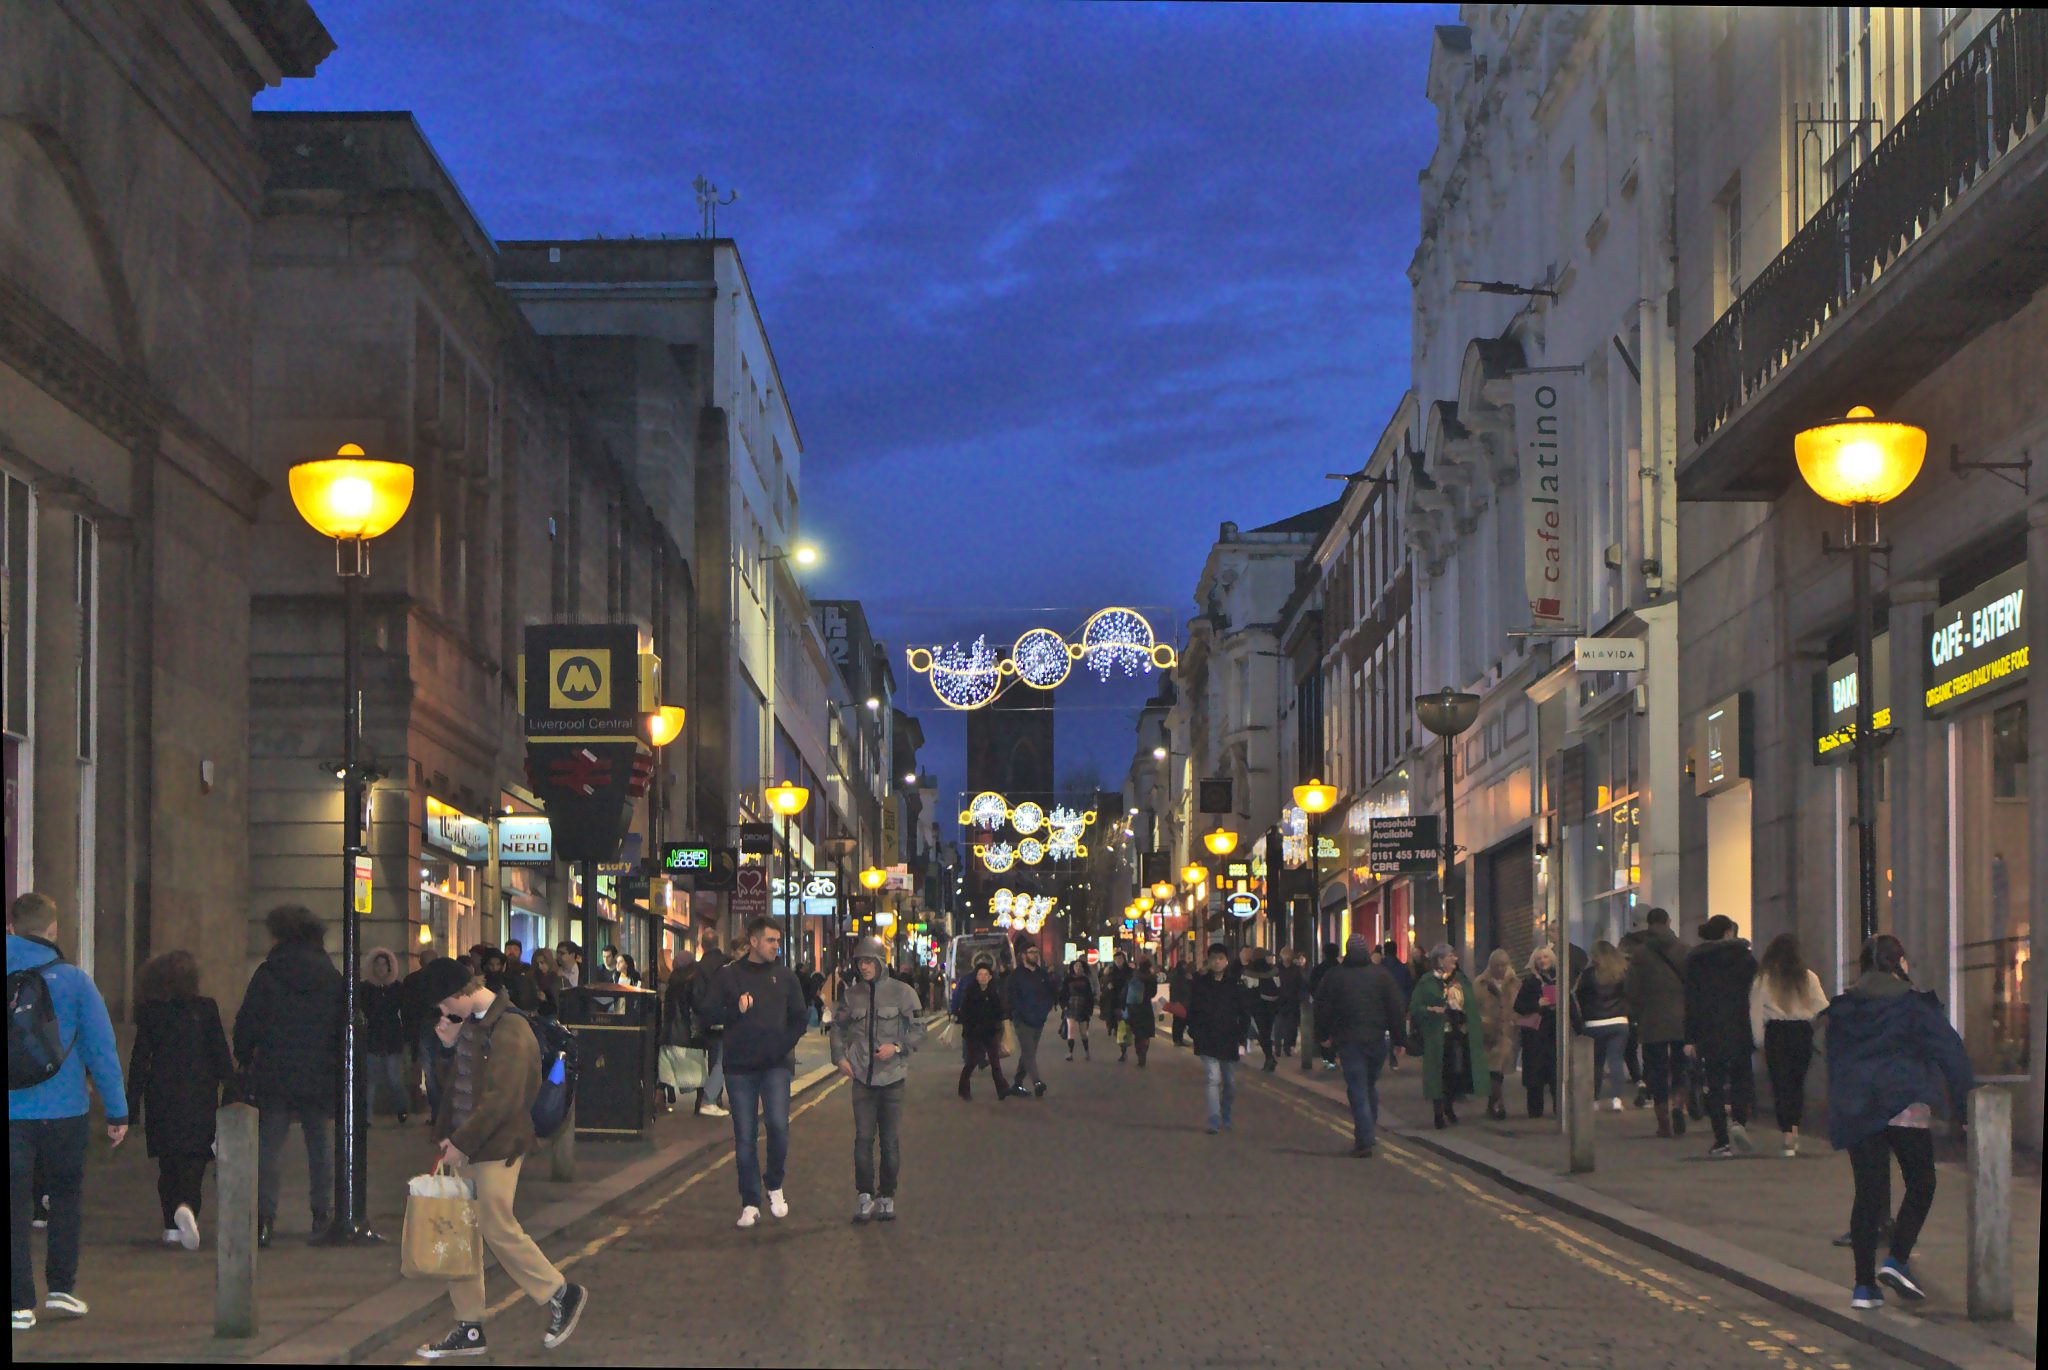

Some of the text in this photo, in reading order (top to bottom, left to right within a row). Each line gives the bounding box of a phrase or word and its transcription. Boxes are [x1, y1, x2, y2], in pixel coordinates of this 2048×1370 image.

[1530, 385, 1560, 583] cafelatino
[1932, 611, 1964, 667] CAFÉ
[1972, 588, 2024, 649] EATERY
[1582, 650, 1635, 659] MI VIDA
[1952, 671, 1973, 697] FRESH
[1973, 663, 1992, 689] DAILY
[1991, 654, 2011, 680] MADE
[1832, 672, 1857, 714] BAK
[529, 718, 633, 731] Liverpool Central
[1372, 817, 1417, 829] Leasehold
[1372, 829, 1414, 839] Available
[502, 842, 548, 853] NERO
[672, 849, 706, 860] NAKED
[1372, 851, 1393, 861] 0161
[1395, 850, 1412, 860] 455
[1372, 861, 1400, 871] CBRE
